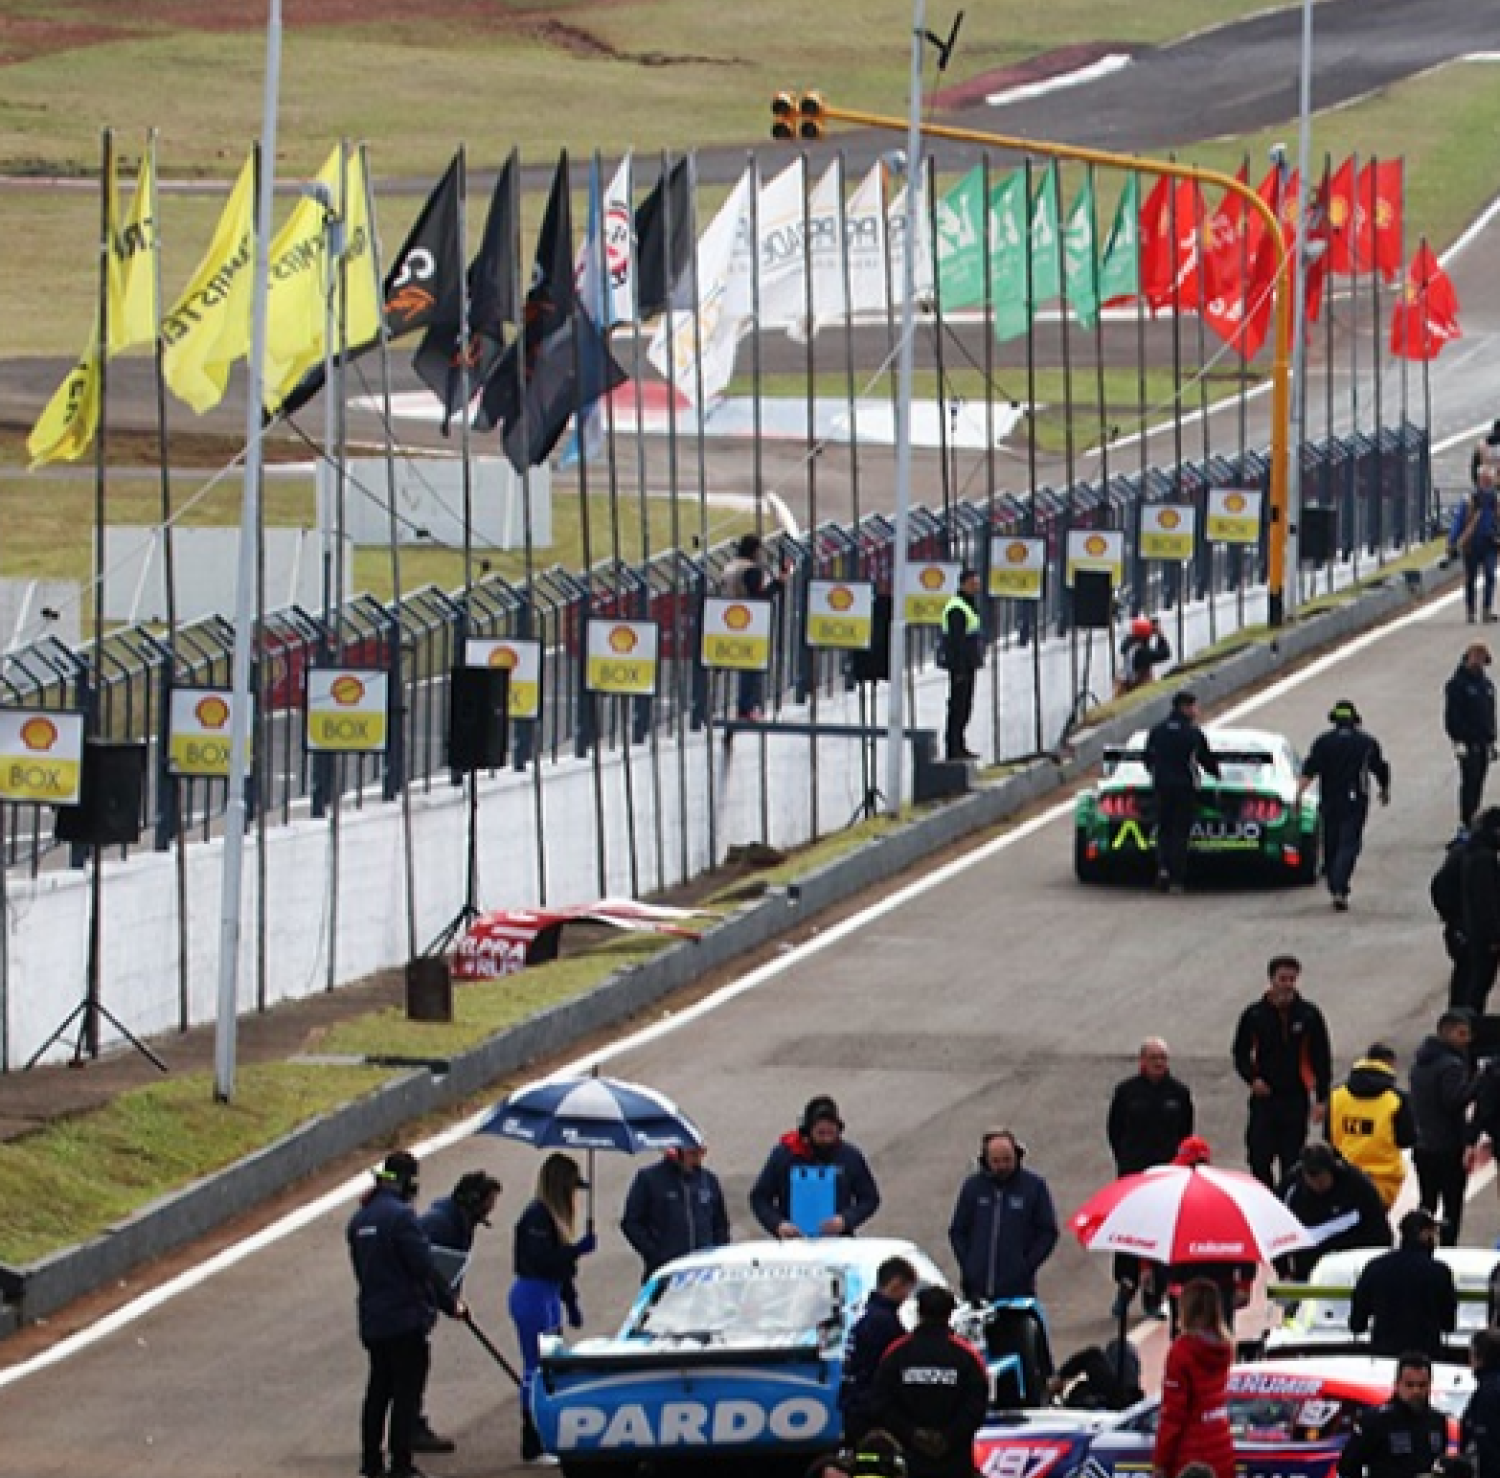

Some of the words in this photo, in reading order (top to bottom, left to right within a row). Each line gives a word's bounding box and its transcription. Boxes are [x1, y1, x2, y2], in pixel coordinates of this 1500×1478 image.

[714, 642, 754, 660] BOX
[597, 666, 640, 684] BOX
[321, 719, 368, 741] BOX
[9, 765, 60, 791] BOX
[556, 1397, 829, 1451] PARDO
